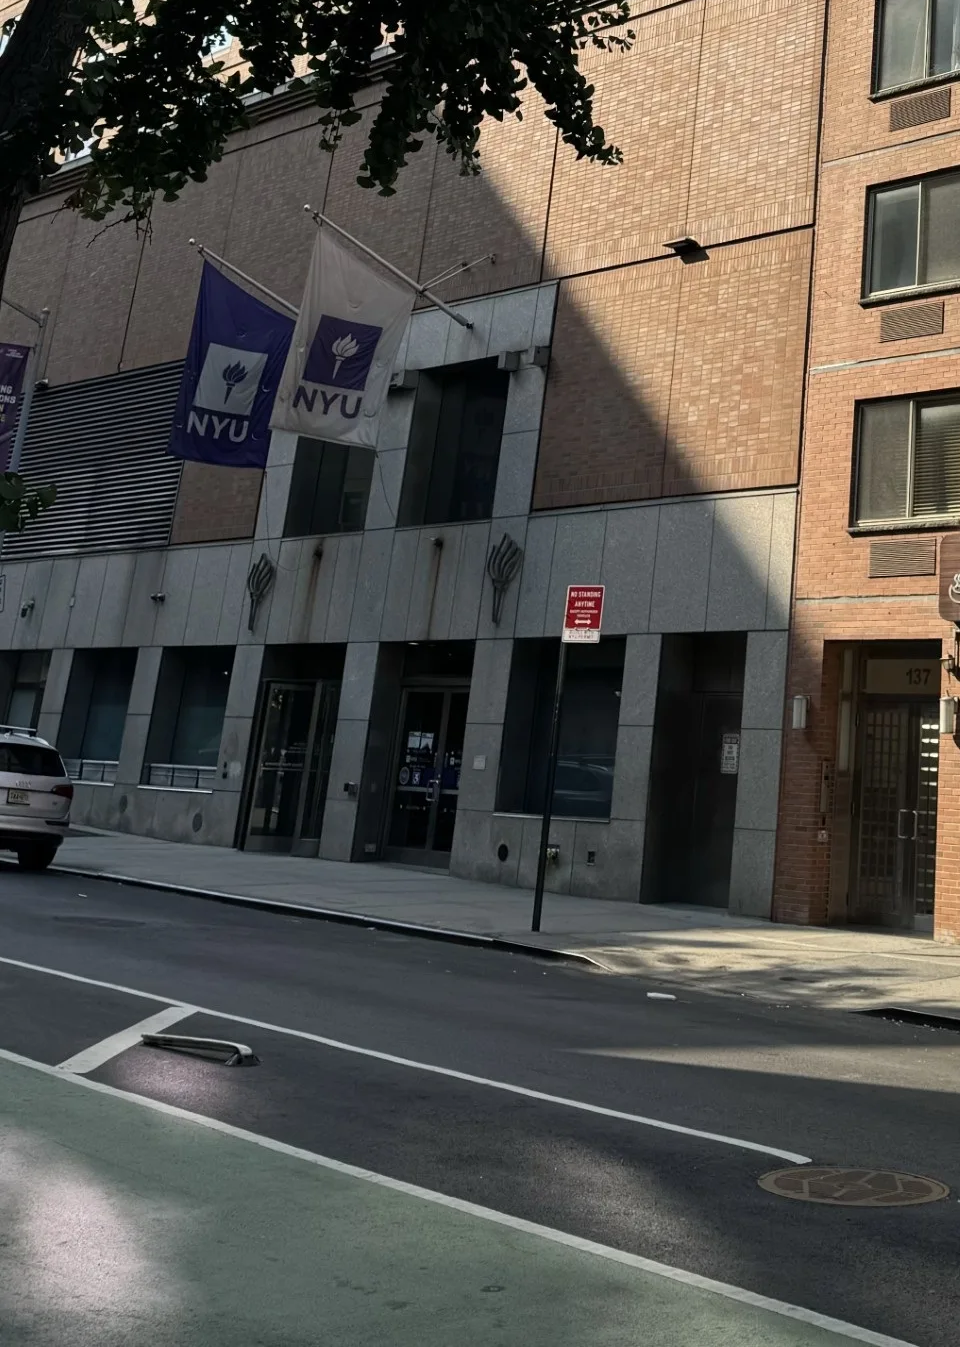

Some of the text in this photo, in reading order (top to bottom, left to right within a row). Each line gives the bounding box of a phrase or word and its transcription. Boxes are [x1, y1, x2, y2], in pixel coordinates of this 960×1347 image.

[292, 386, 364, 420] NYU
[186, 410, 250, 443] NYU
[905, 667, 932, 686] 137
